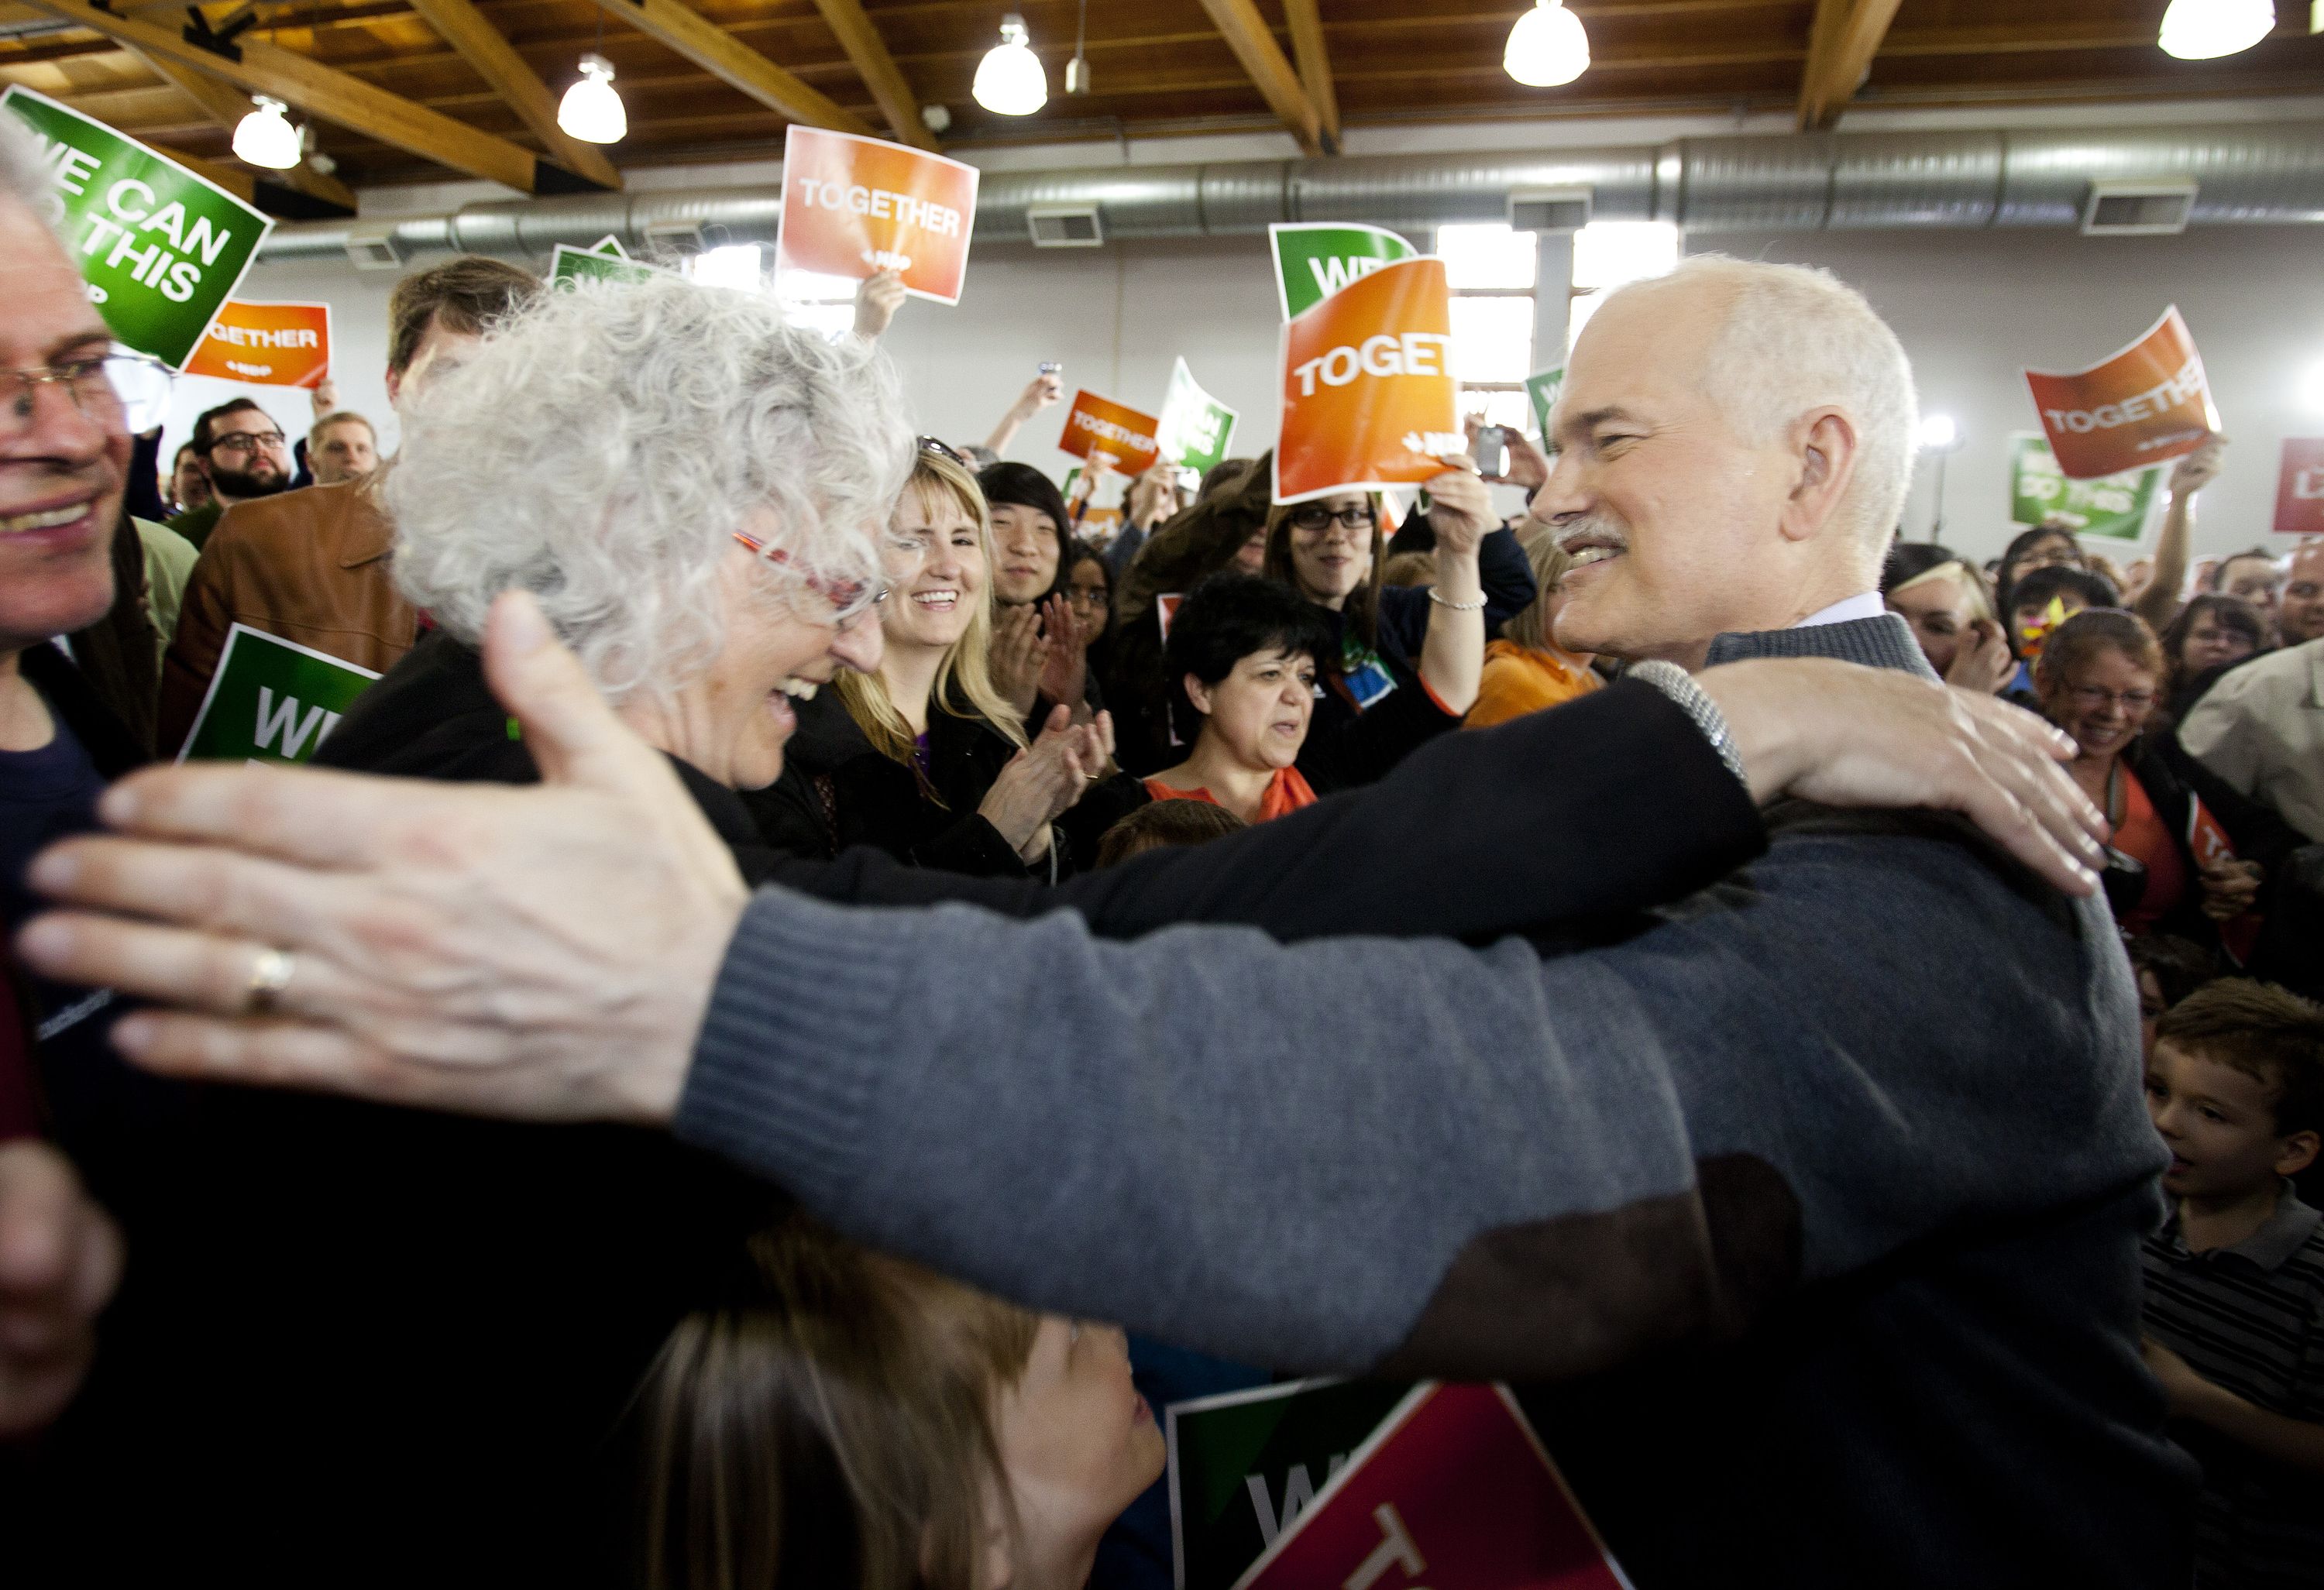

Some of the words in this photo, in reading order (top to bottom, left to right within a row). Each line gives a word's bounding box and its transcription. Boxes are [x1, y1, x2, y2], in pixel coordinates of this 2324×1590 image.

[107, 179, 231, 266] CAN
[799, 178, 961, 238] TOGETHER
[82, 211, 201, 303] THIS
[208, 321, 318, 348] GETHER
[1294, 332, 1452, 397] TOGET
[1074, 410, 1157, 455] TOGETHER
